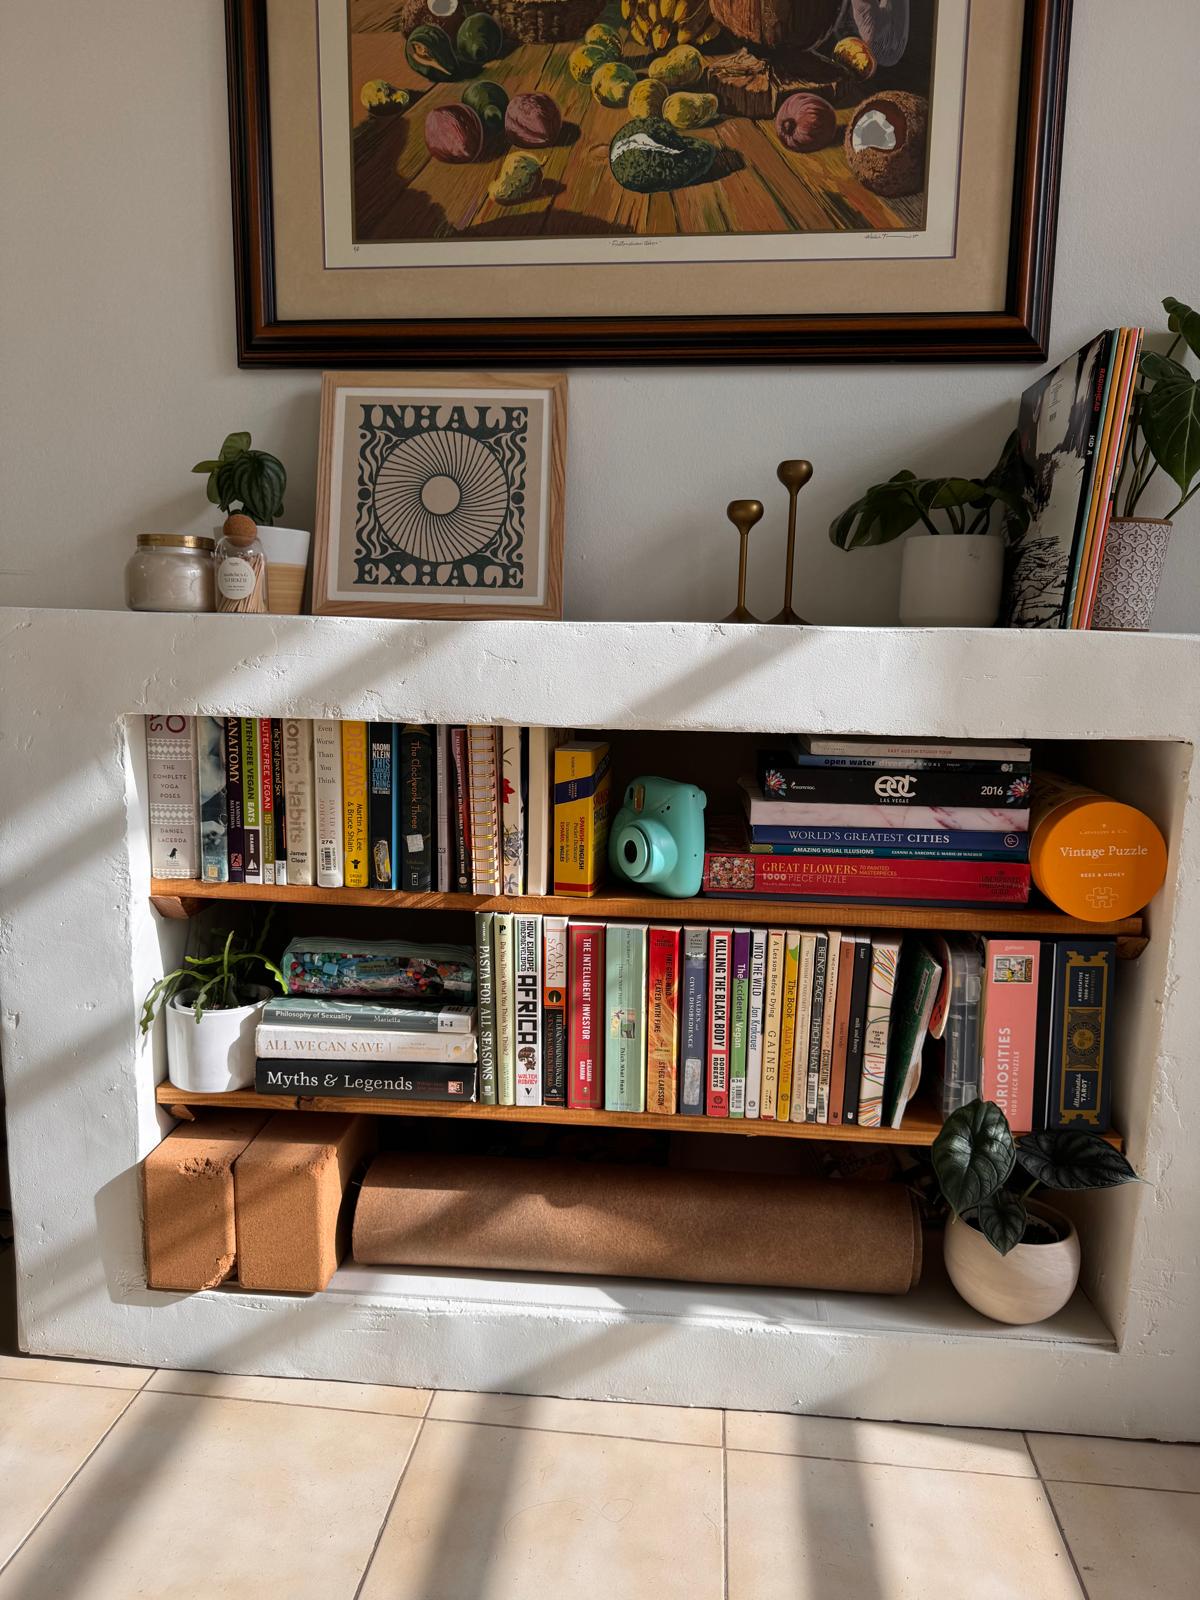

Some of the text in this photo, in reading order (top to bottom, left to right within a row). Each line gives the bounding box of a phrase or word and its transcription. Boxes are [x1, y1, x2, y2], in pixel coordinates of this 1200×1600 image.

[1093, 367, 1106, 413] RADIOHEAD
[358, 404, 529, 434] INHALE
[1087, 434, 1096, 448] KID
[353, 559, 525, 589] EXHALE
[228, 716, 240, 784] ANATOMY
[316, 738, 335, 746] Worse
[372, 743, 391, 751] NAOMI
[262, 720, 271, 809] LUTEN-FREE VEGAN
[317, 751, 334, 759] Than
[347, 724, 363, 798] DREAMS
[372, 750, 391, 759] KLEIN
[372, 758, 391, 768] THIS
[824, 759, 876, 768] open water
[245, 718, 256, 823] UTEN-FREE VEGAN EATS
[320, 764, 332, 772] You
[286, 718, 306, 844] tomic Habits
[406, 741, 421, 829] The Clockwork Three
[980, 785, 1004, 796] 2016
[347, 808, 355, 830] Bruce
[356, 803, 364, 827] Martin
[347, 830, 355, 853] Shlain
[356, 827, 364, 836] A.
[788, 829, 950, 846] WORLD'S GREATEST CITIES
[1060, 844, 1149, 859] Vintage Puzzle
[761, 862, 859, 876] GREAT FLOWERS
[762, 873, 848, 885] 1000 PIECE PUZZLE
[526, 920, 535, 972] HOW EUROPE
[479, 945, 490, 980] PASTA
[547, 938, 556, 980] SAGAN
[555, 942, 564, 977] CARL
[752, 942, 764, 996] INTO THE WILD
[771, 948, 779, 972] Lesson
[770, 974, 778, 996] Before
[815, 946, 826, 1002] BEING PEACE
[480, 982, 491, 1005] FOR
[500, 979, 508, 996] What
[582, 938, 592, 1040] THE INTELLIGENT INVESTOR
[654, 979, 662, 1001] PLAYED
[714, 938, 726, 1047] KILLING THE BLACK BODY
[786, 979, 796, 1019] The Book
[500, 996, 508, 1008] You
[517, 974, 537, 1045] AFRICA
[687, 976, 696, 1049] CIVIL DISOBEDIENCE
[695, 993, 703, 1022] WALDEN
[768, 998, 777, 1018] Dying
[275, 1010, 352, 1022] Philosophy of Sexuality
[480, 1007, 491, 1028] ALL
[653, 1019, 661, 1033] FIRE
[501, 1024, 509, 1035] You
[749, 1006, 760, 1051] Jon Krakauer
[265, 1039, 292, 1051] ALL
[293, 1040, 315, 1051] WE
[317, 1040, 347, 1052] CAN
[351, 1041, 384, 1053] SAVE
[481, 1030, 493, 1080] SEASONS
[501, 1035, 509, 1056] Think?
[766, 1030, 776, 1081] GAINES
[782, 1025, 794, 1083] Alan W. Watts
[811, 1017, 821, 1070] THICH NHAT
[266, 1070, 318, 1088] Myths
[323, 1073, 338, 1087] &
[344, 1073, 413, 1092] Legends
[656, 1079, 665, 1106] LARSSON
[1080, 1079, 1088, 1103] TAROT
